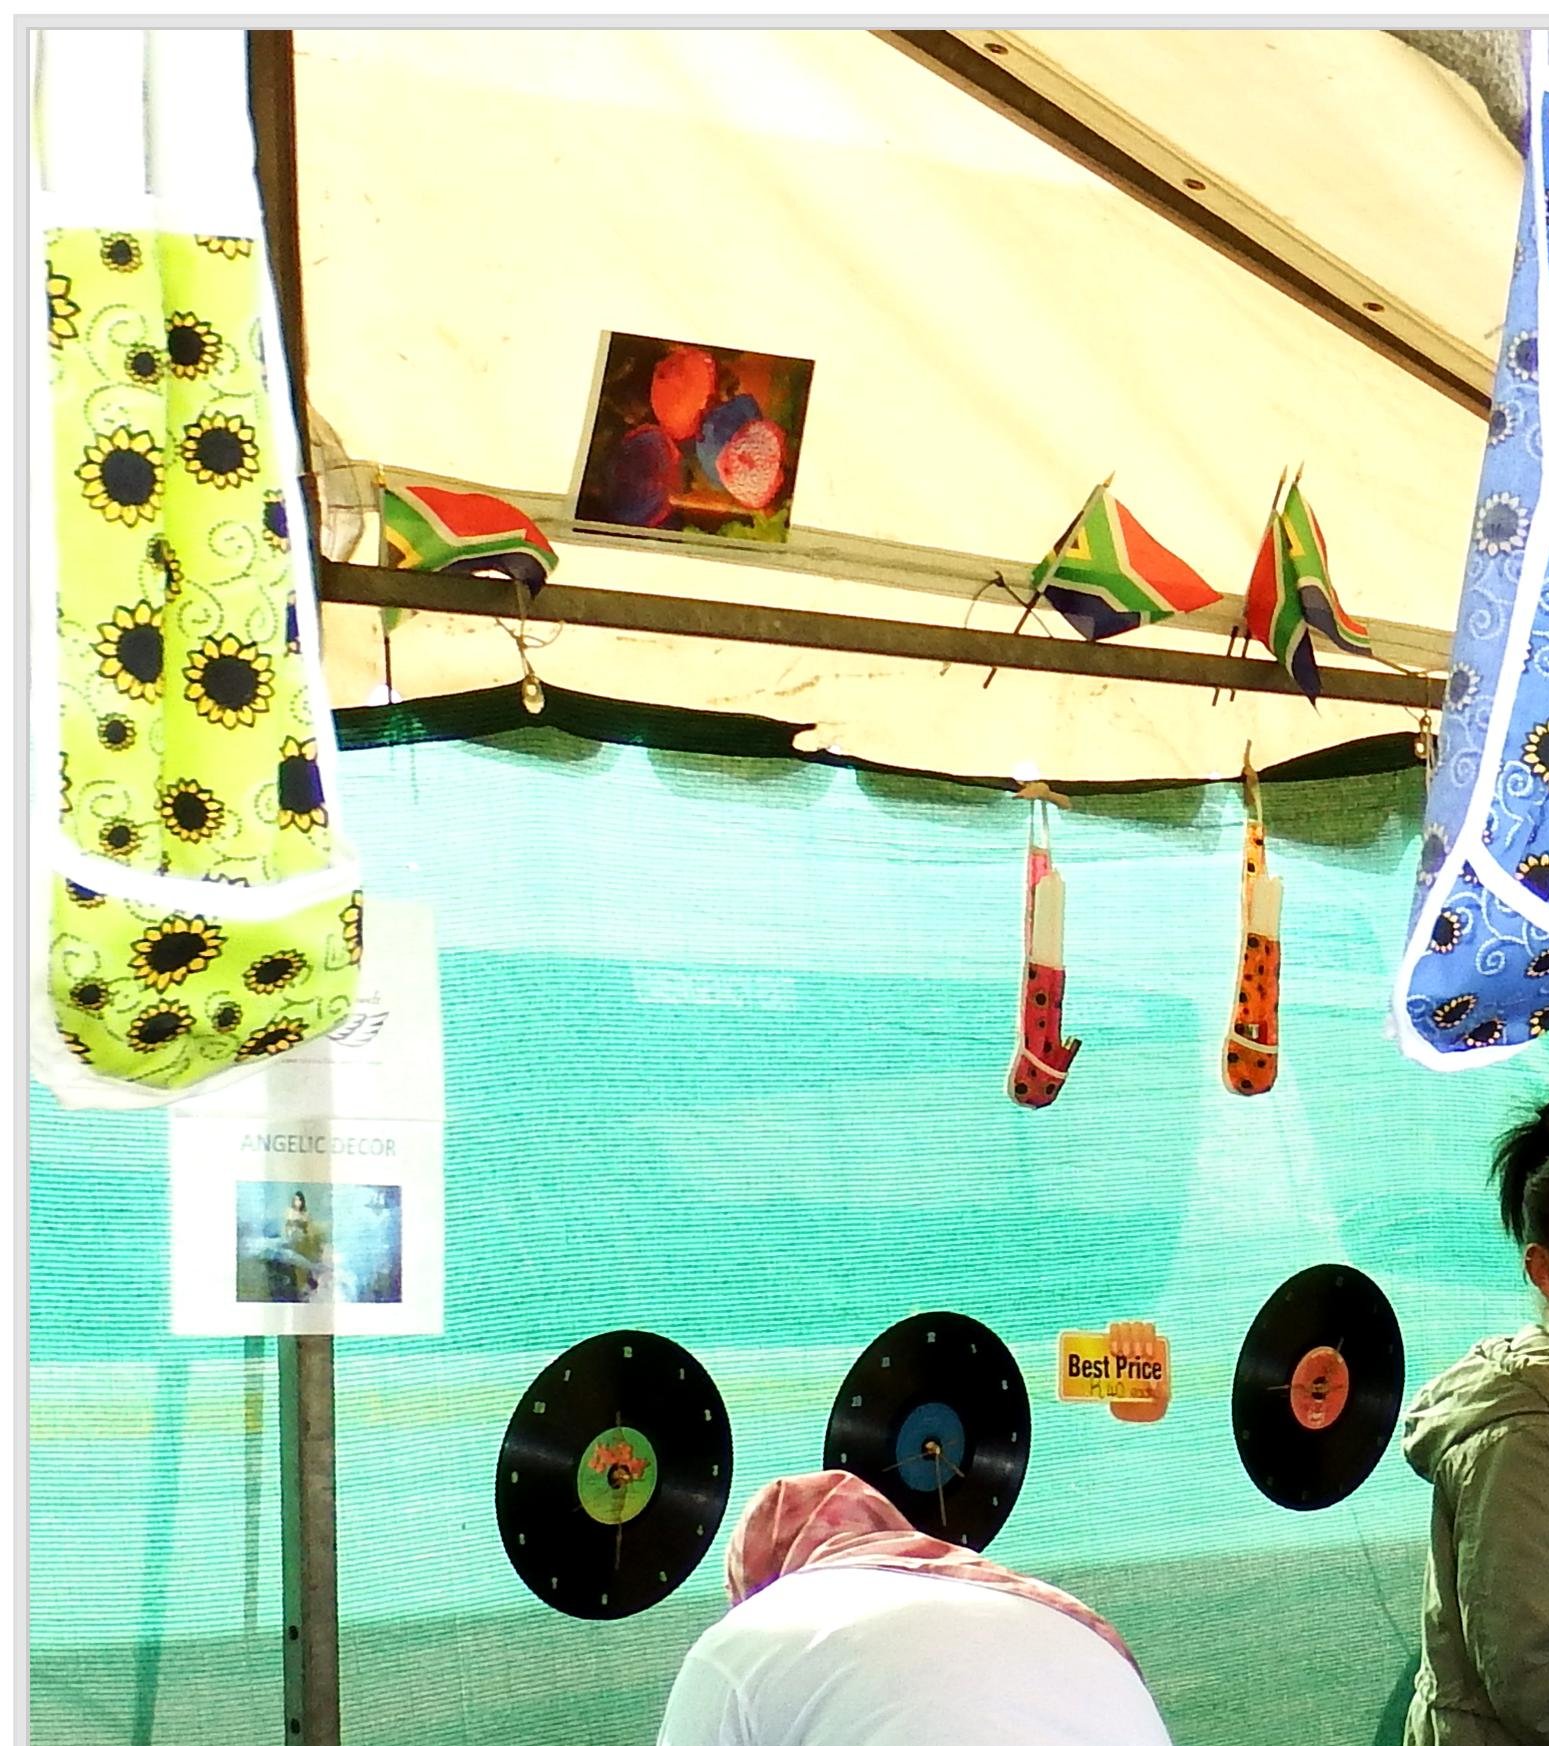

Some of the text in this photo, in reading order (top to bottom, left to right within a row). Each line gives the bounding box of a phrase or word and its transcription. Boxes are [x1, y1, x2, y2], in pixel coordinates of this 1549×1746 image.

[240, 1134, 397, 1157] ANGELIC DECOR
[1068, 1353, 1162, 1380] Best Price
